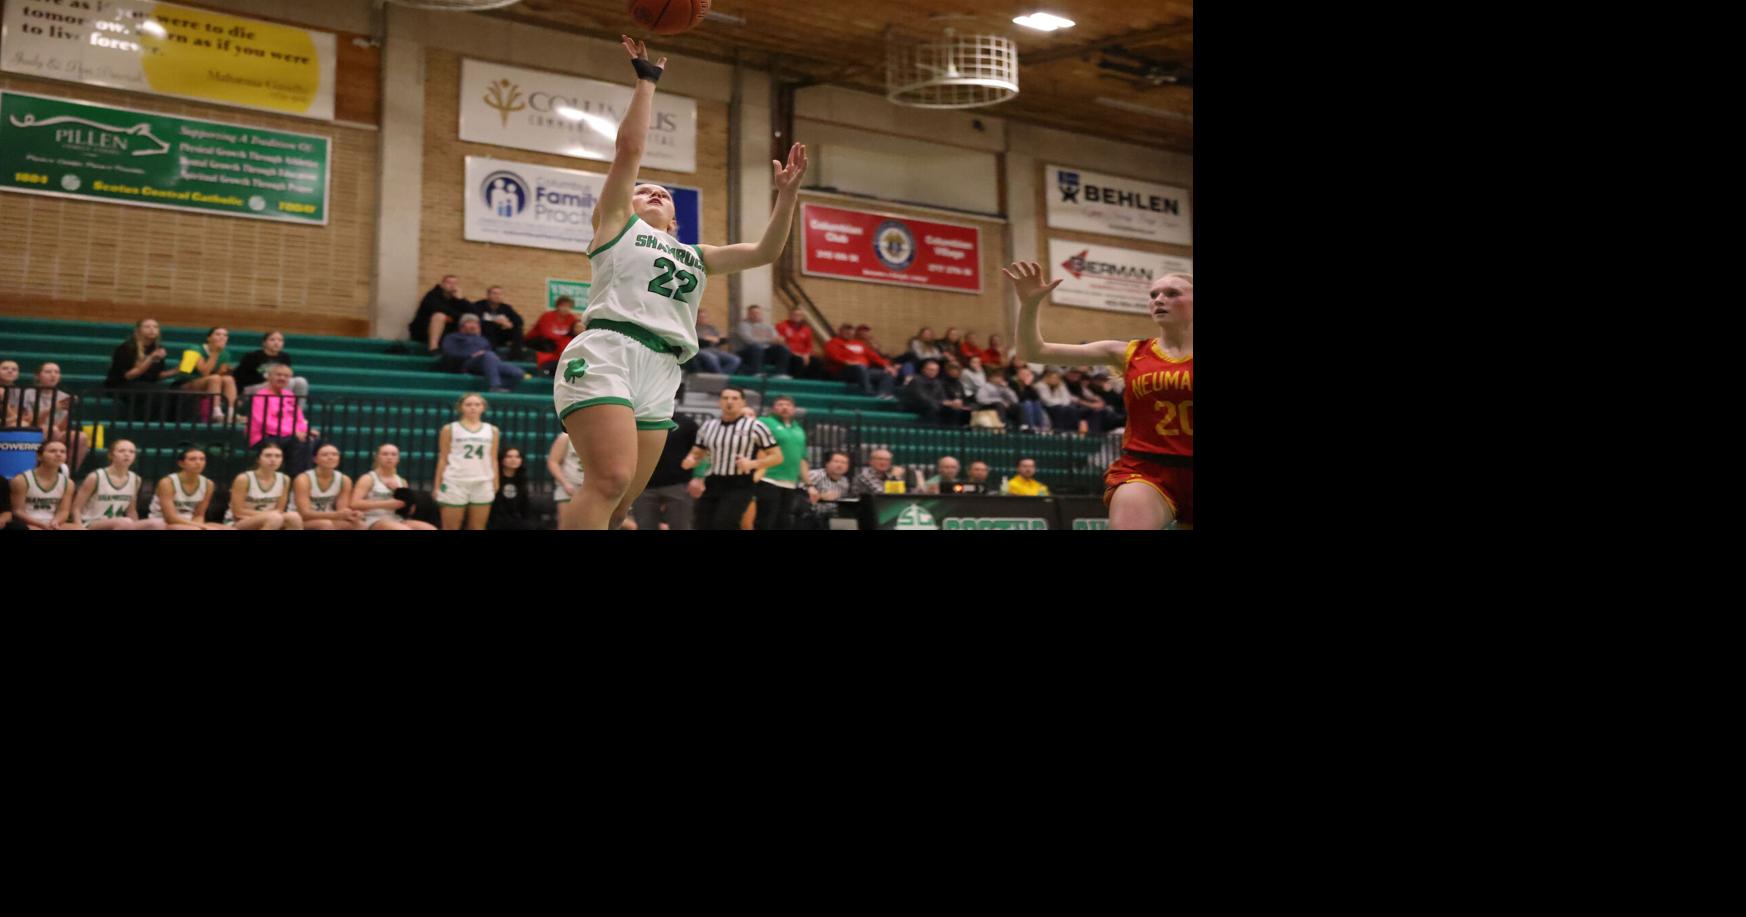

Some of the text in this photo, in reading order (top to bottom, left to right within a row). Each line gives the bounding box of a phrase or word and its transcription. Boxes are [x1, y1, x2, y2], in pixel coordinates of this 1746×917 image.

[22, 23, 43, 35] to
[157, 15, 198, 30] were
[205, 23, 223, 35] to
[228, 26, 255, 40] die
[193, 38, 213, 48] as
[216, 38, 231, 52] if
[235, 45, 265, 57] you
[271, 52, 310, 65] were
[55, 129, 128, 150] PILLEN
[141, 185, 190, 201] Central
[191, 191, 244, 207] Catholic
[1084, 184, 1179, 216] BEHLEN
[648, 256, 698, 304] 22
[1132, 370, 1193, 399] NEUMA
[1154, 400, 1193, 436] 20
[464, 444, 485, 460] 24
